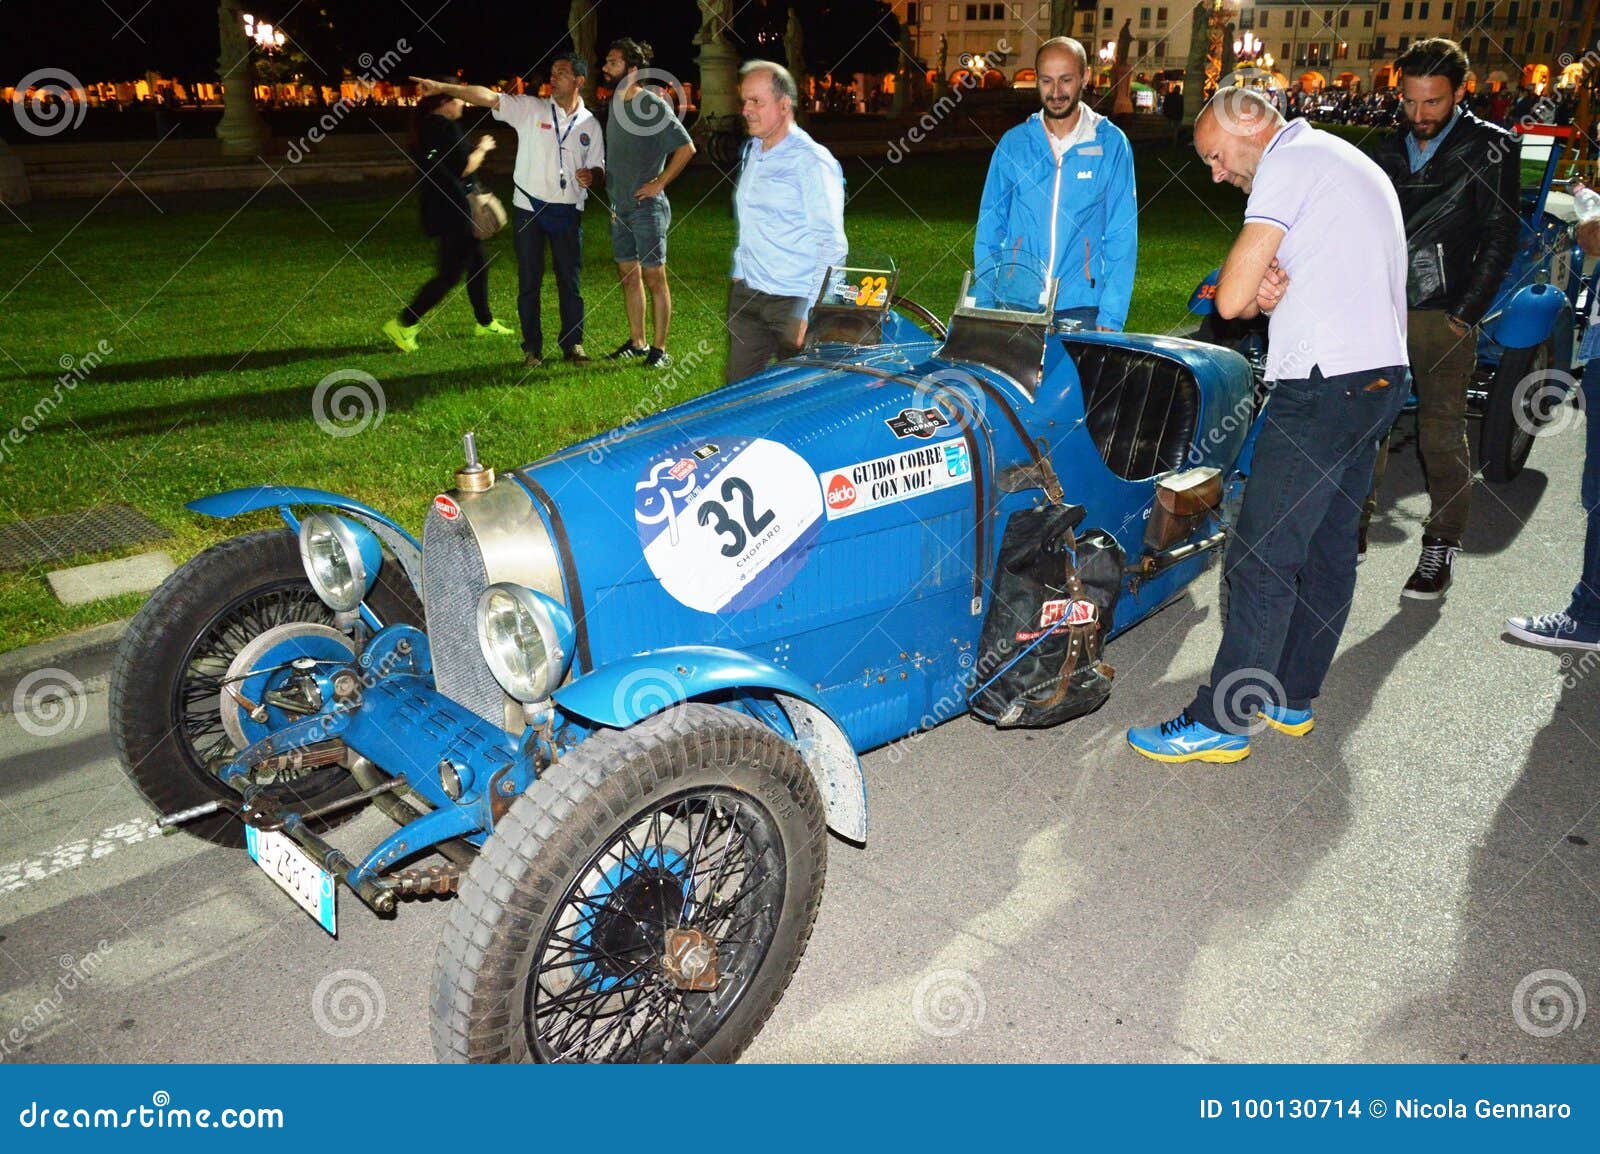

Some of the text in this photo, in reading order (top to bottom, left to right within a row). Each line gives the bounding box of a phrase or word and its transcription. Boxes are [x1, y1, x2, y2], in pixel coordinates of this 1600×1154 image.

[856, 276, 887, 306] 32
[903, 420, 940, 434] CHOPARD
[853, 446, 943, 485] GUIDO CORRE
[828, 483, 856, 504] aido
[872, 468, 932, 501] CON NOI!
[697, 476, 776, 558] 32
[736, 524, 781, 567] CHOPARD
